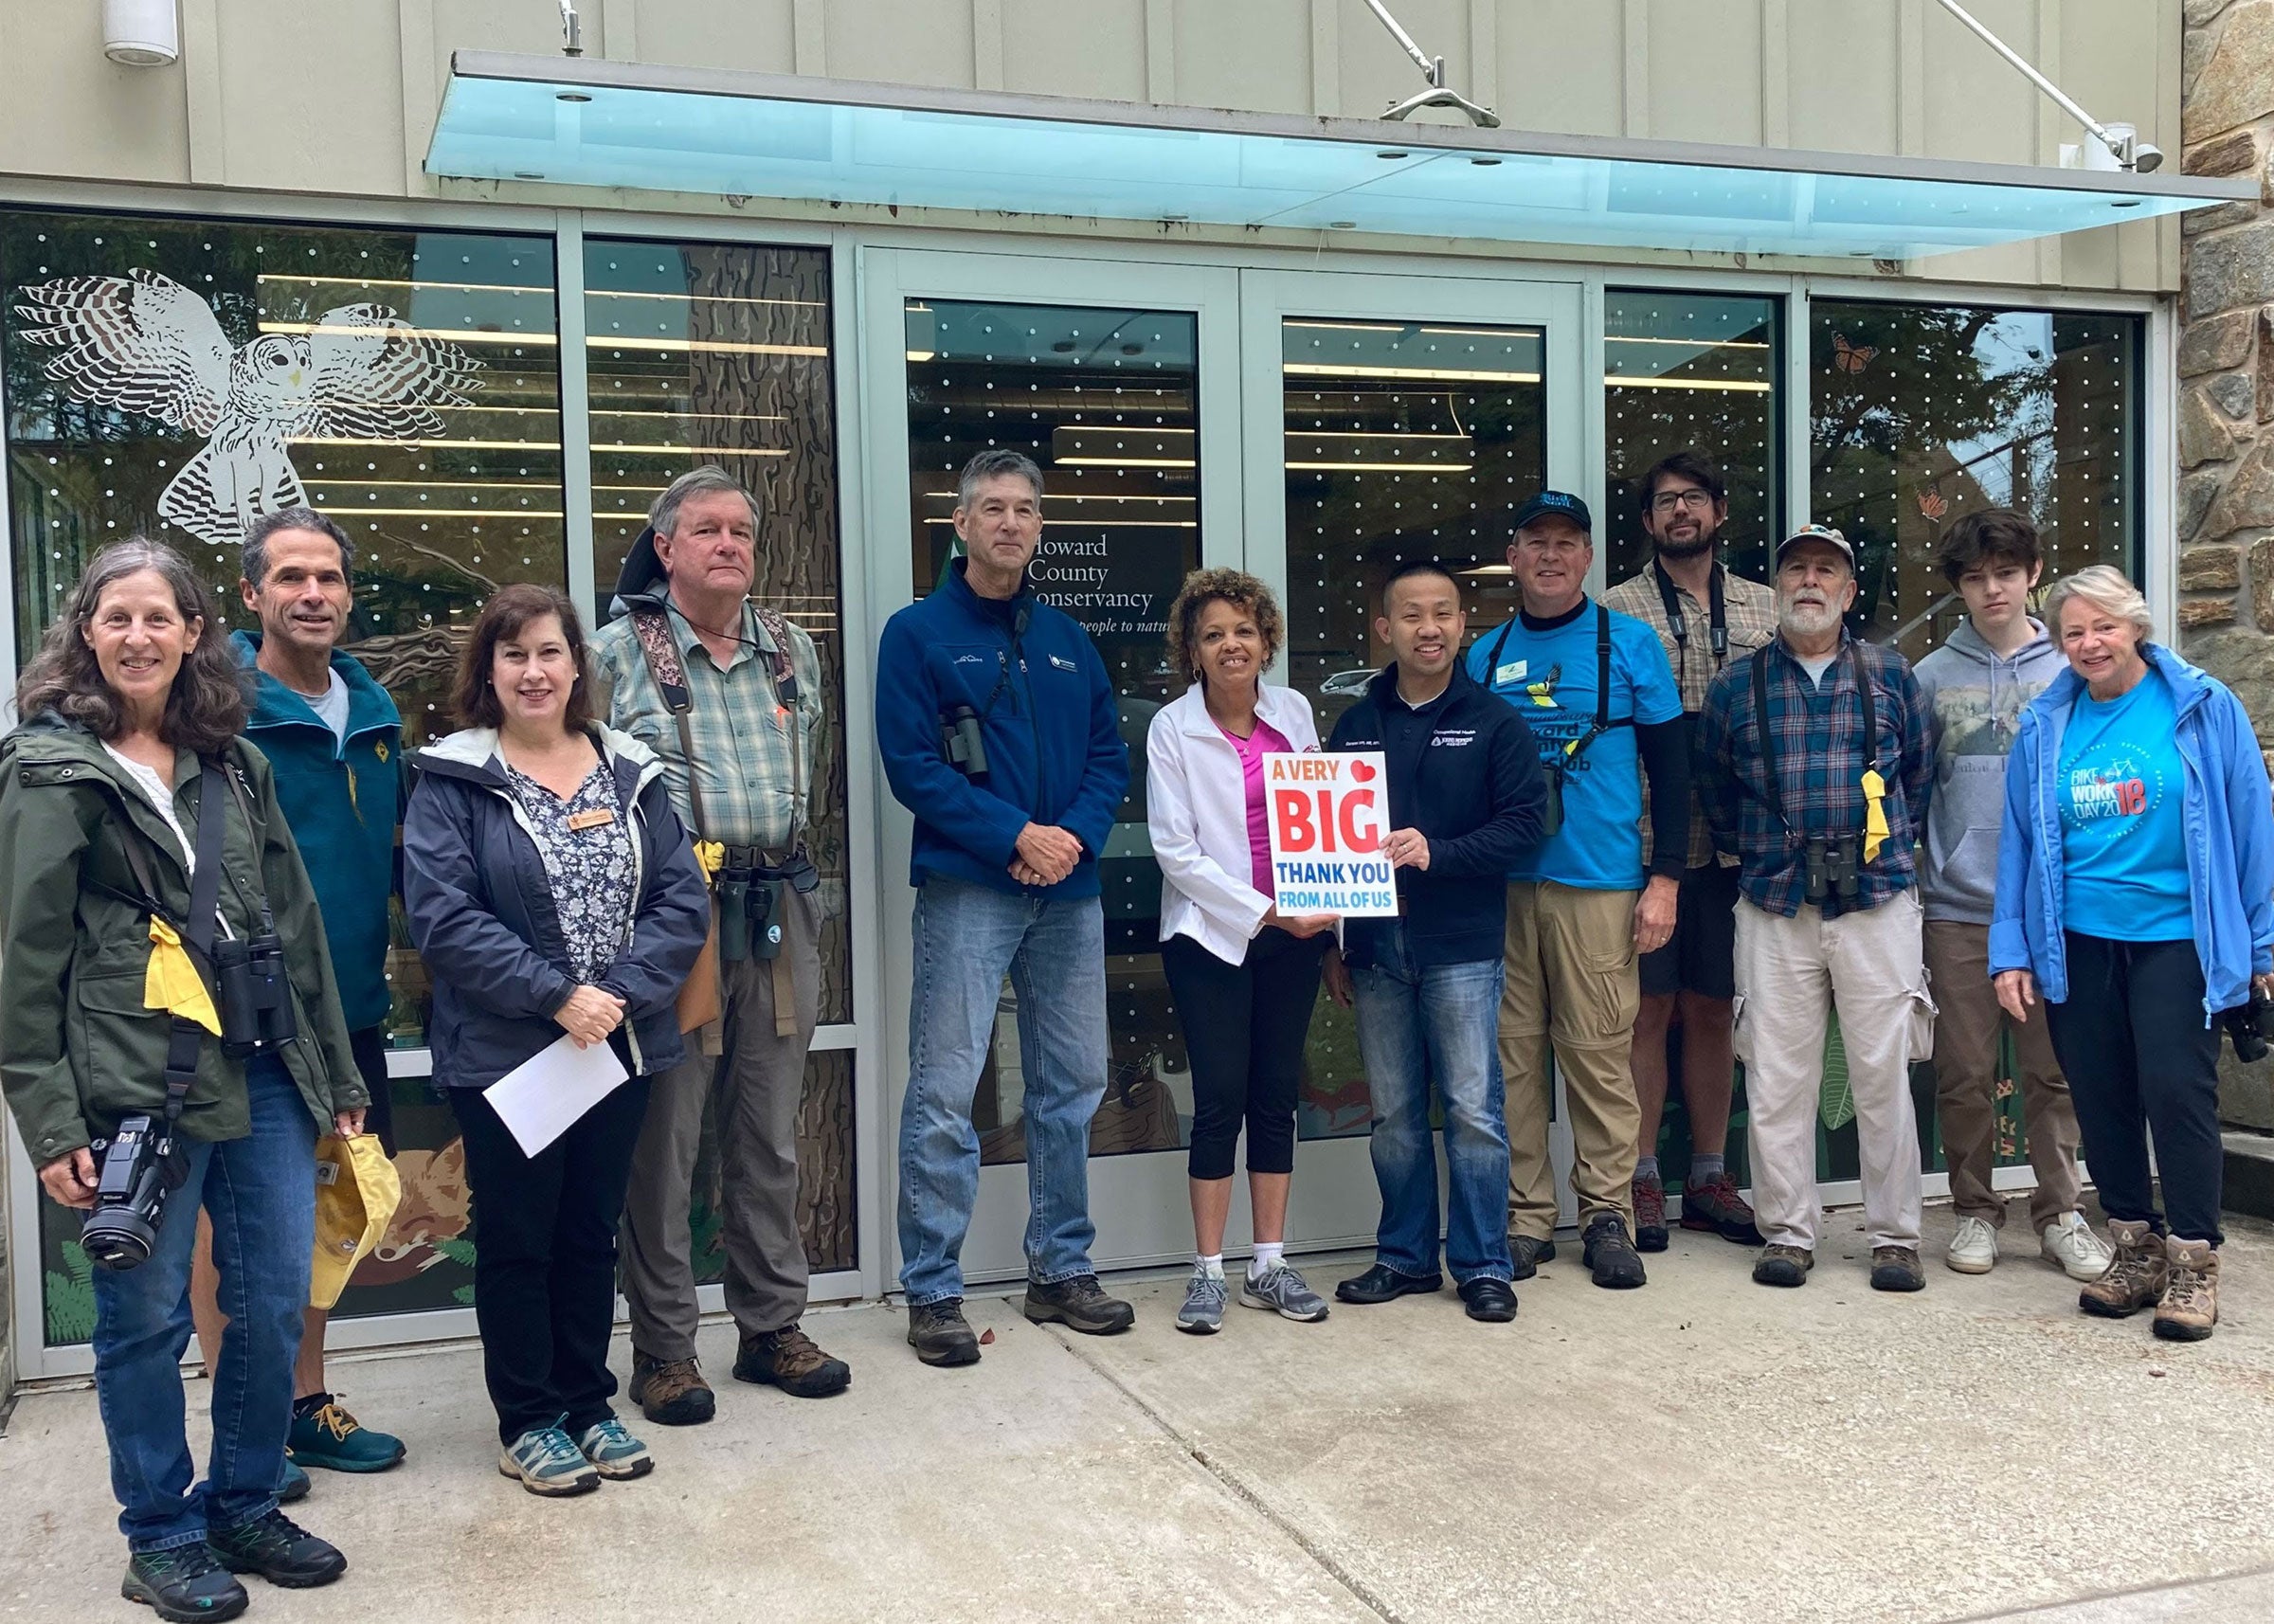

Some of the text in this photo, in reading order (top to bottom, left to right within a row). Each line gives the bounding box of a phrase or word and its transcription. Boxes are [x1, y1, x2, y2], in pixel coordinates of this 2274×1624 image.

[1028, 559, 1109, 590] County
[1029, 585, 1153, 615] onservancy
[1121, 621, 1133, 632] to
[1272, 759, 1340, 781] A VERY
[2071, 767, 2099, 786] BIKE
[2070, 782, 2118, 803] WORK
[1274, 788, 1380, 854] BIG
[2073, 802, 2101, 820] DAY
[1276, 862, 1390, 884] THANK YOU
[1279, 892, 1392, 908] FROM ALL OF US
